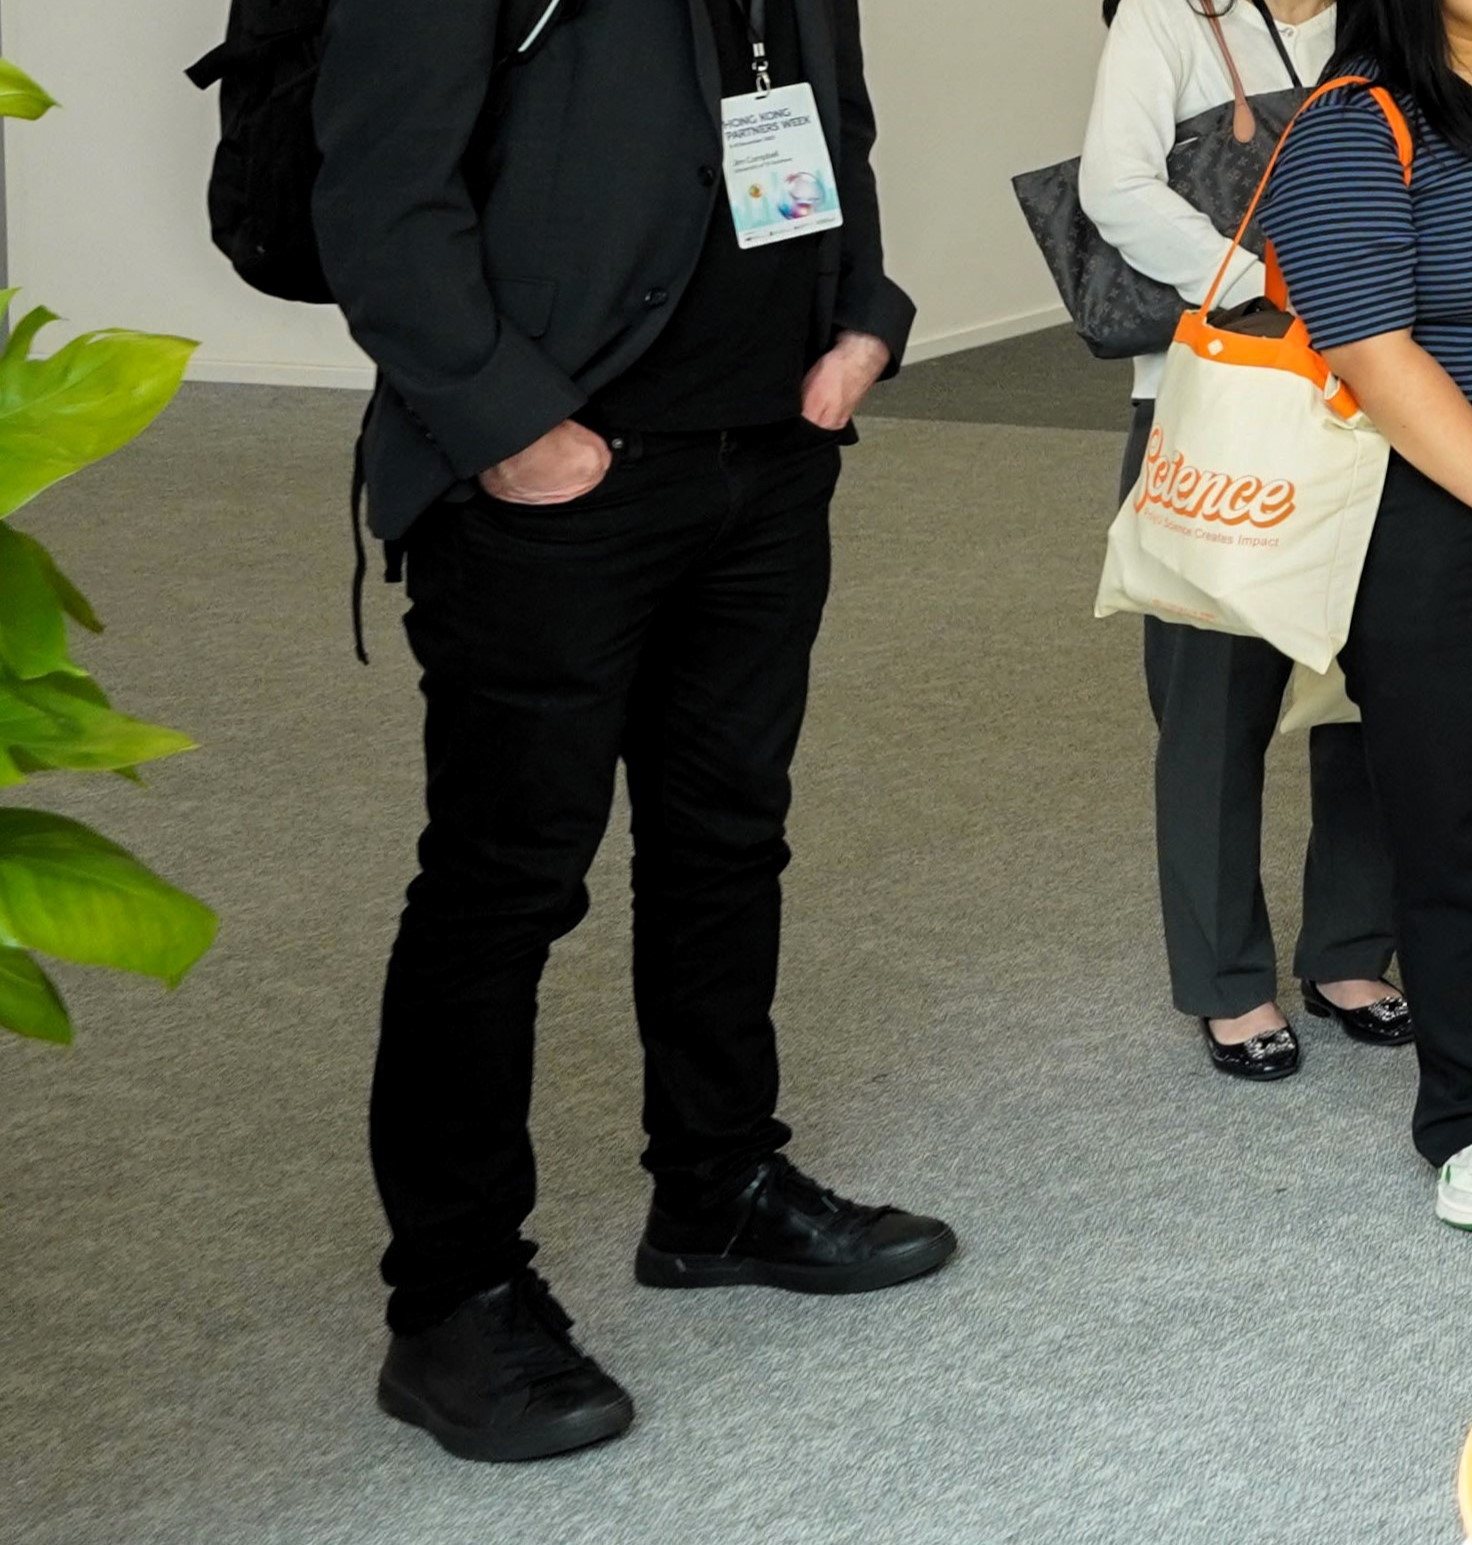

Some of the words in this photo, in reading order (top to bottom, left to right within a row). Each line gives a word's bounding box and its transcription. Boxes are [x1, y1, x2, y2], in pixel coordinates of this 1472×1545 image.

[723, 114, 758, 129] HONG
[759, 108, 792, 121] KONG
[725, 122, 780, 140] PARTNERS
[782, 115, 811, 129] WEEK
[1134, 425, 1296, 530] Science
[1194, 528, 1234, 545] Creates
[1238, 534, 1280, 548] Impact
